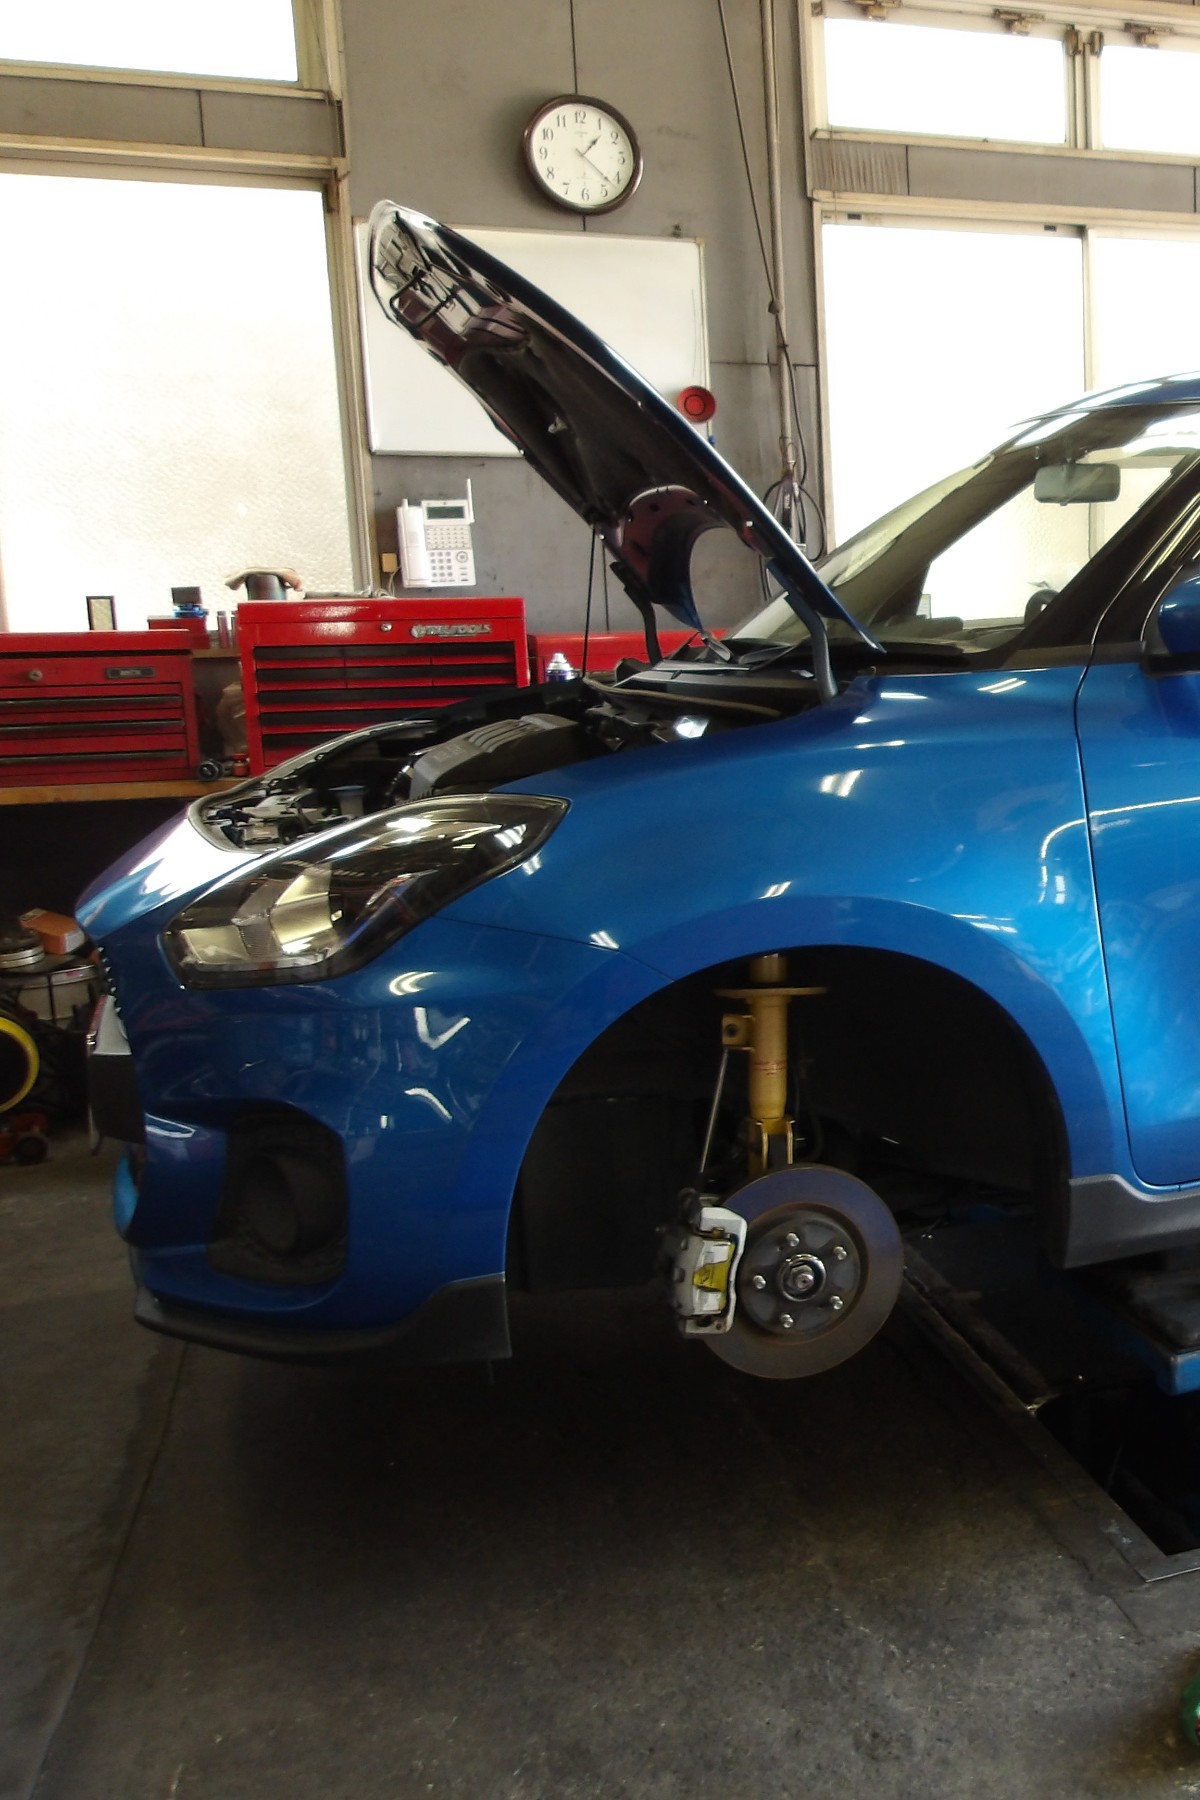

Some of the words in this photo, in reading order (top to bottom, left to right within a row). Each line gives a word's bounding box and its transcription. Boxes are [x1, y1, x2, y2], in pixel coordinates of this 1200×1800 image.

[556, 114, 566, 128] 11
[574, 110, 587, 125] 12
[542, 127, 554, 141] 10
[610, 131, 619, 145] 2
[539, 146, 548, 161] 9
[546, 166, 555, 180] 8
[612, 170, 620, 185] 4
[562, 181, 571, 196] 7
[581, 187, 590, 202] 6
[600, 183, 609, 198] 5
